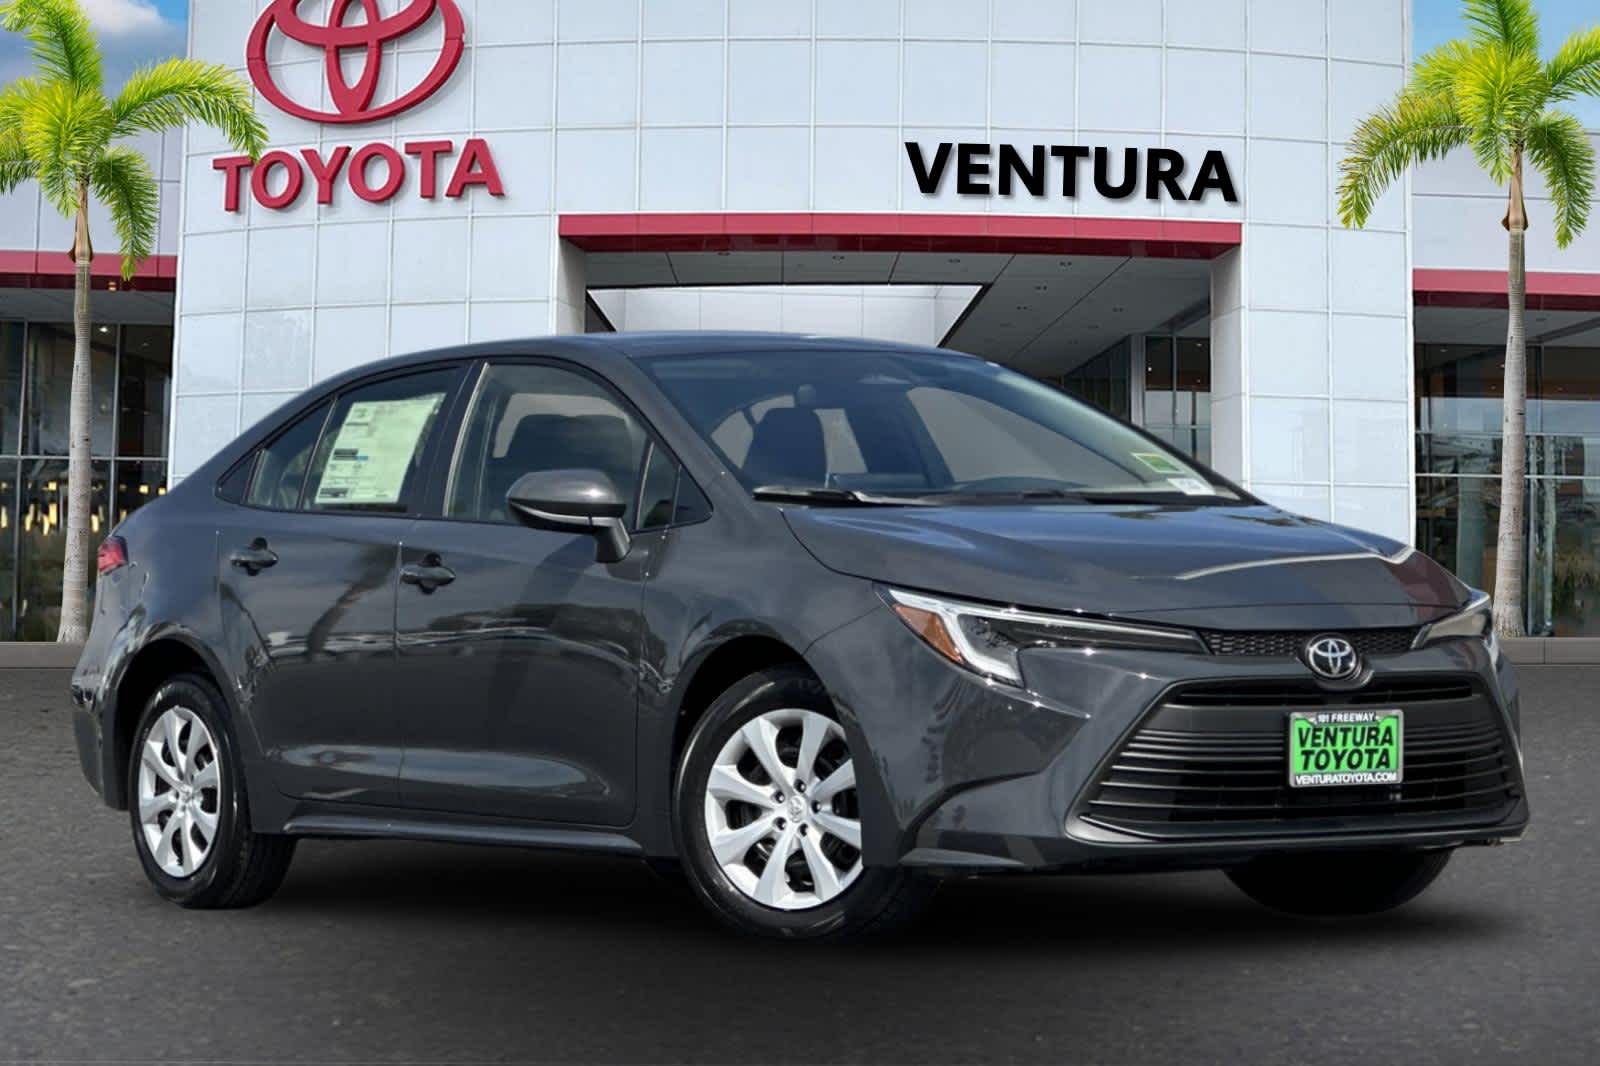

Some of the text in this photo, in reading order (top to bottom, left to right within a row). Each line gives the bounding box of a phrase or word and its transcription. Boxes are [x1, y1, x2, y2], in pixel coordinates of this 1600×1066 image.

[212, 138, 505, 212] TOYOTA
[904, 141, 1238, 203] VENTURA
[1331, 712, 1375, 722] FREEWAY
[1298, 726, 1394, 748] VENTURA
[1300, 747, 1391, 771] TOYOTA
[1295, 772, 1397, 785] VENTURATOYOTA.COM
